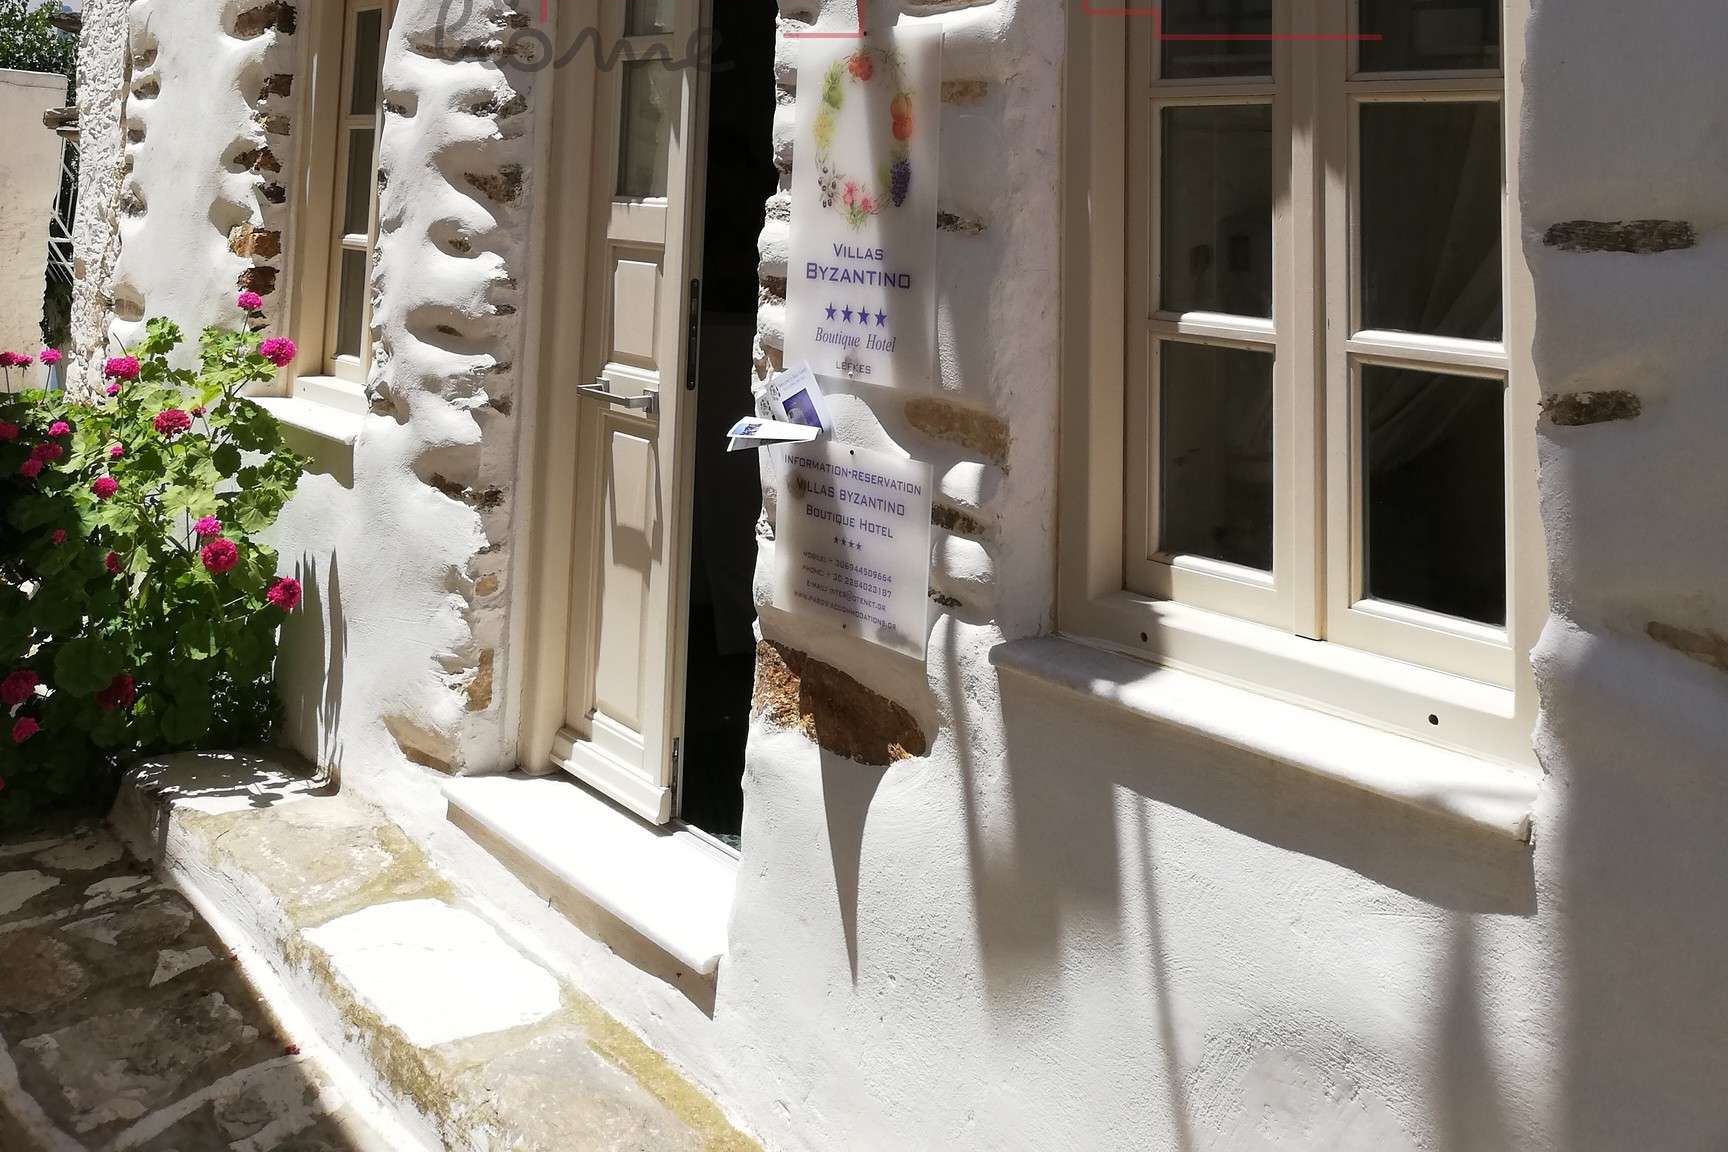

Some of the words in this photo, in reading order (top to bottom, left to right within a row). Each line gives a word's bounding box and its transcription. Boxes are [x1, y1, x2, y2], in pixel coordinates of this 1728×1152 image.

[833, 243, 884, 261] VILLAS
[806, 262, 911, 289] BYZANTINO
[815, 327, 860, 349] Boutique
[866, 333, 897, 353] Hotel
[797, 476, 835, 498] VILLAS
[839, 489, 905, 517] BYZANTINO
[806, 504, 855, 528] BOUTIQUE
[859, 518, 894, 539] HOTEL
